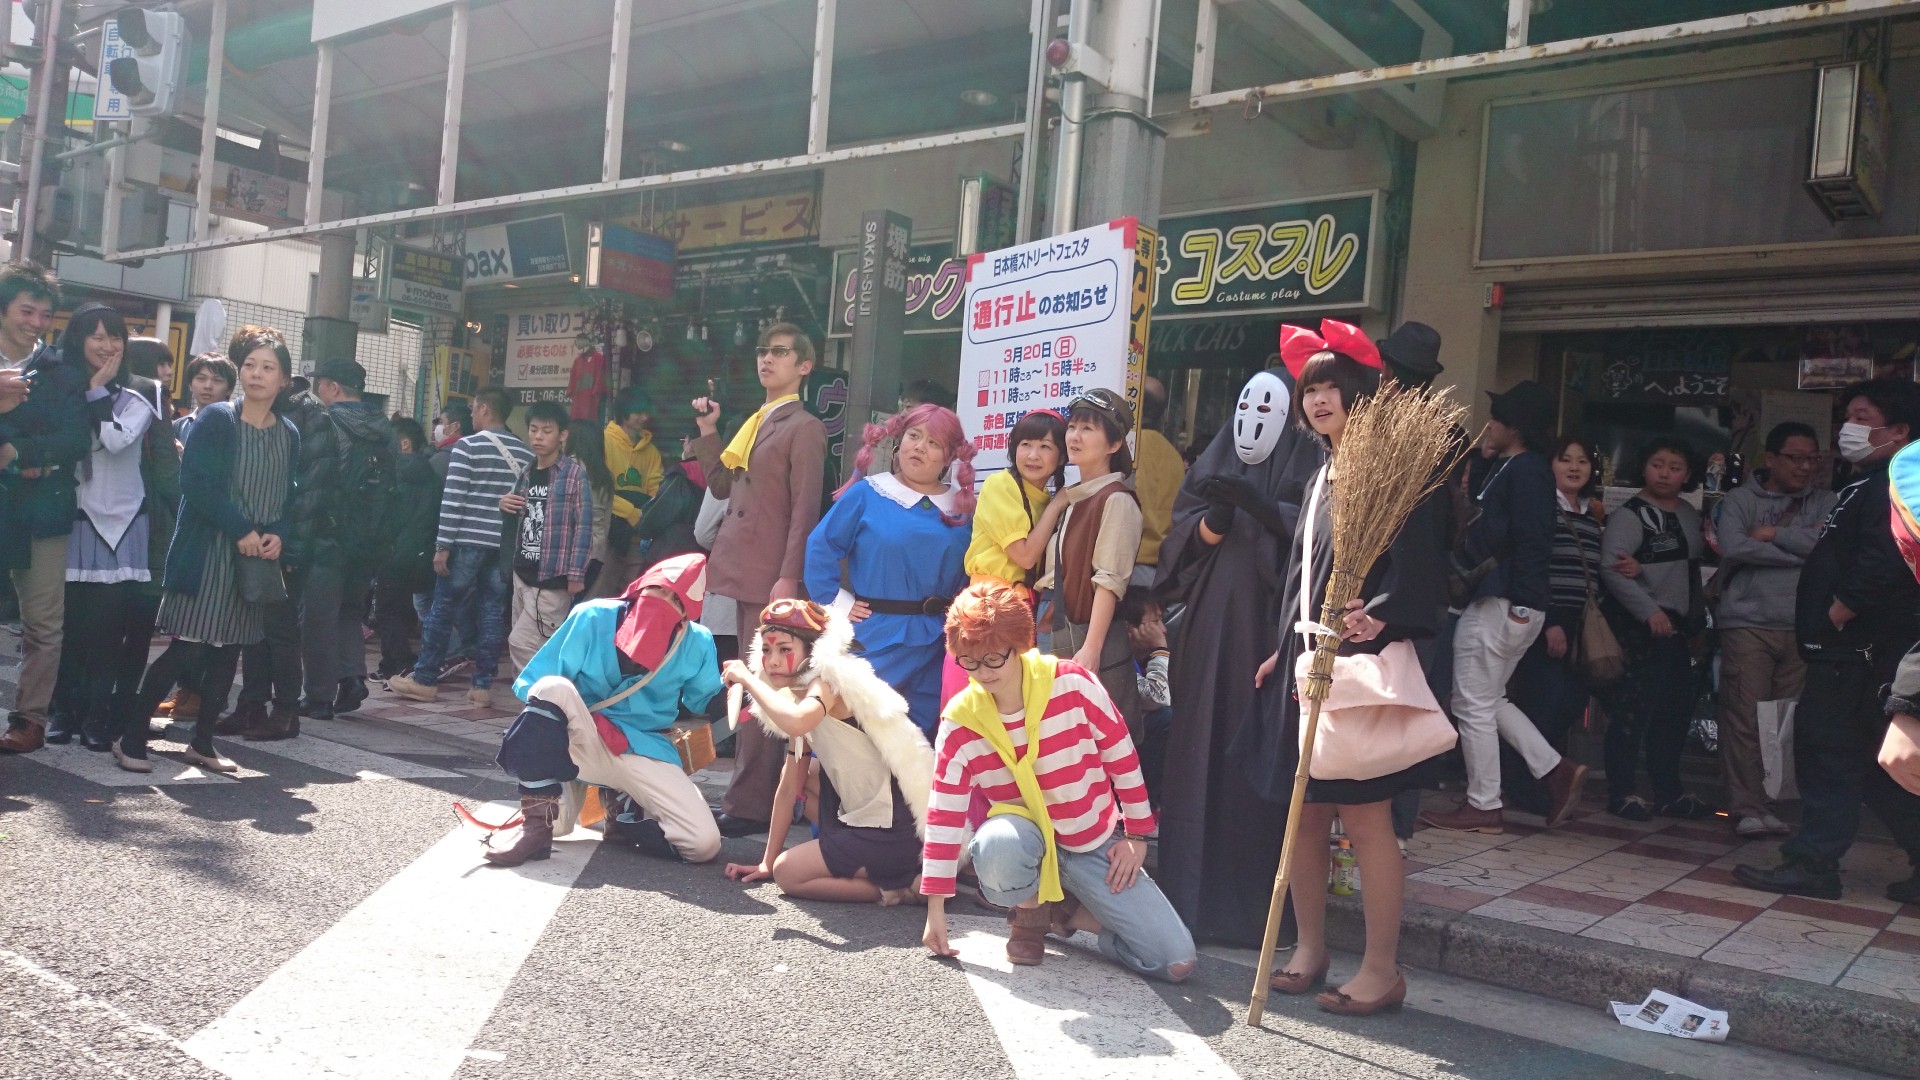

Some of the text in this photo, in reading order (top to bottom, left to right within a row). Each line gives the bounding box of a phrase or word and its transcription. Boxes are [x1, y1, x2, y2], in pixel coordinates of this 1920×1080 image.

[858, 221, 878, 317] SAKAI-SUJI
[883, 222, 909, 293] 堺筋
[993, 237, 1090, 278] 日本橋ストリートフェスタ
[1172, 214, 1359, 306] コスプレ
[413, 287, 449, 302] mobax
[973, 284, 1109, 331] 通行止のお知らせ
[1216, 288, 1301, 303] Costume play
[1194, 320, 1252, 351] CATS
